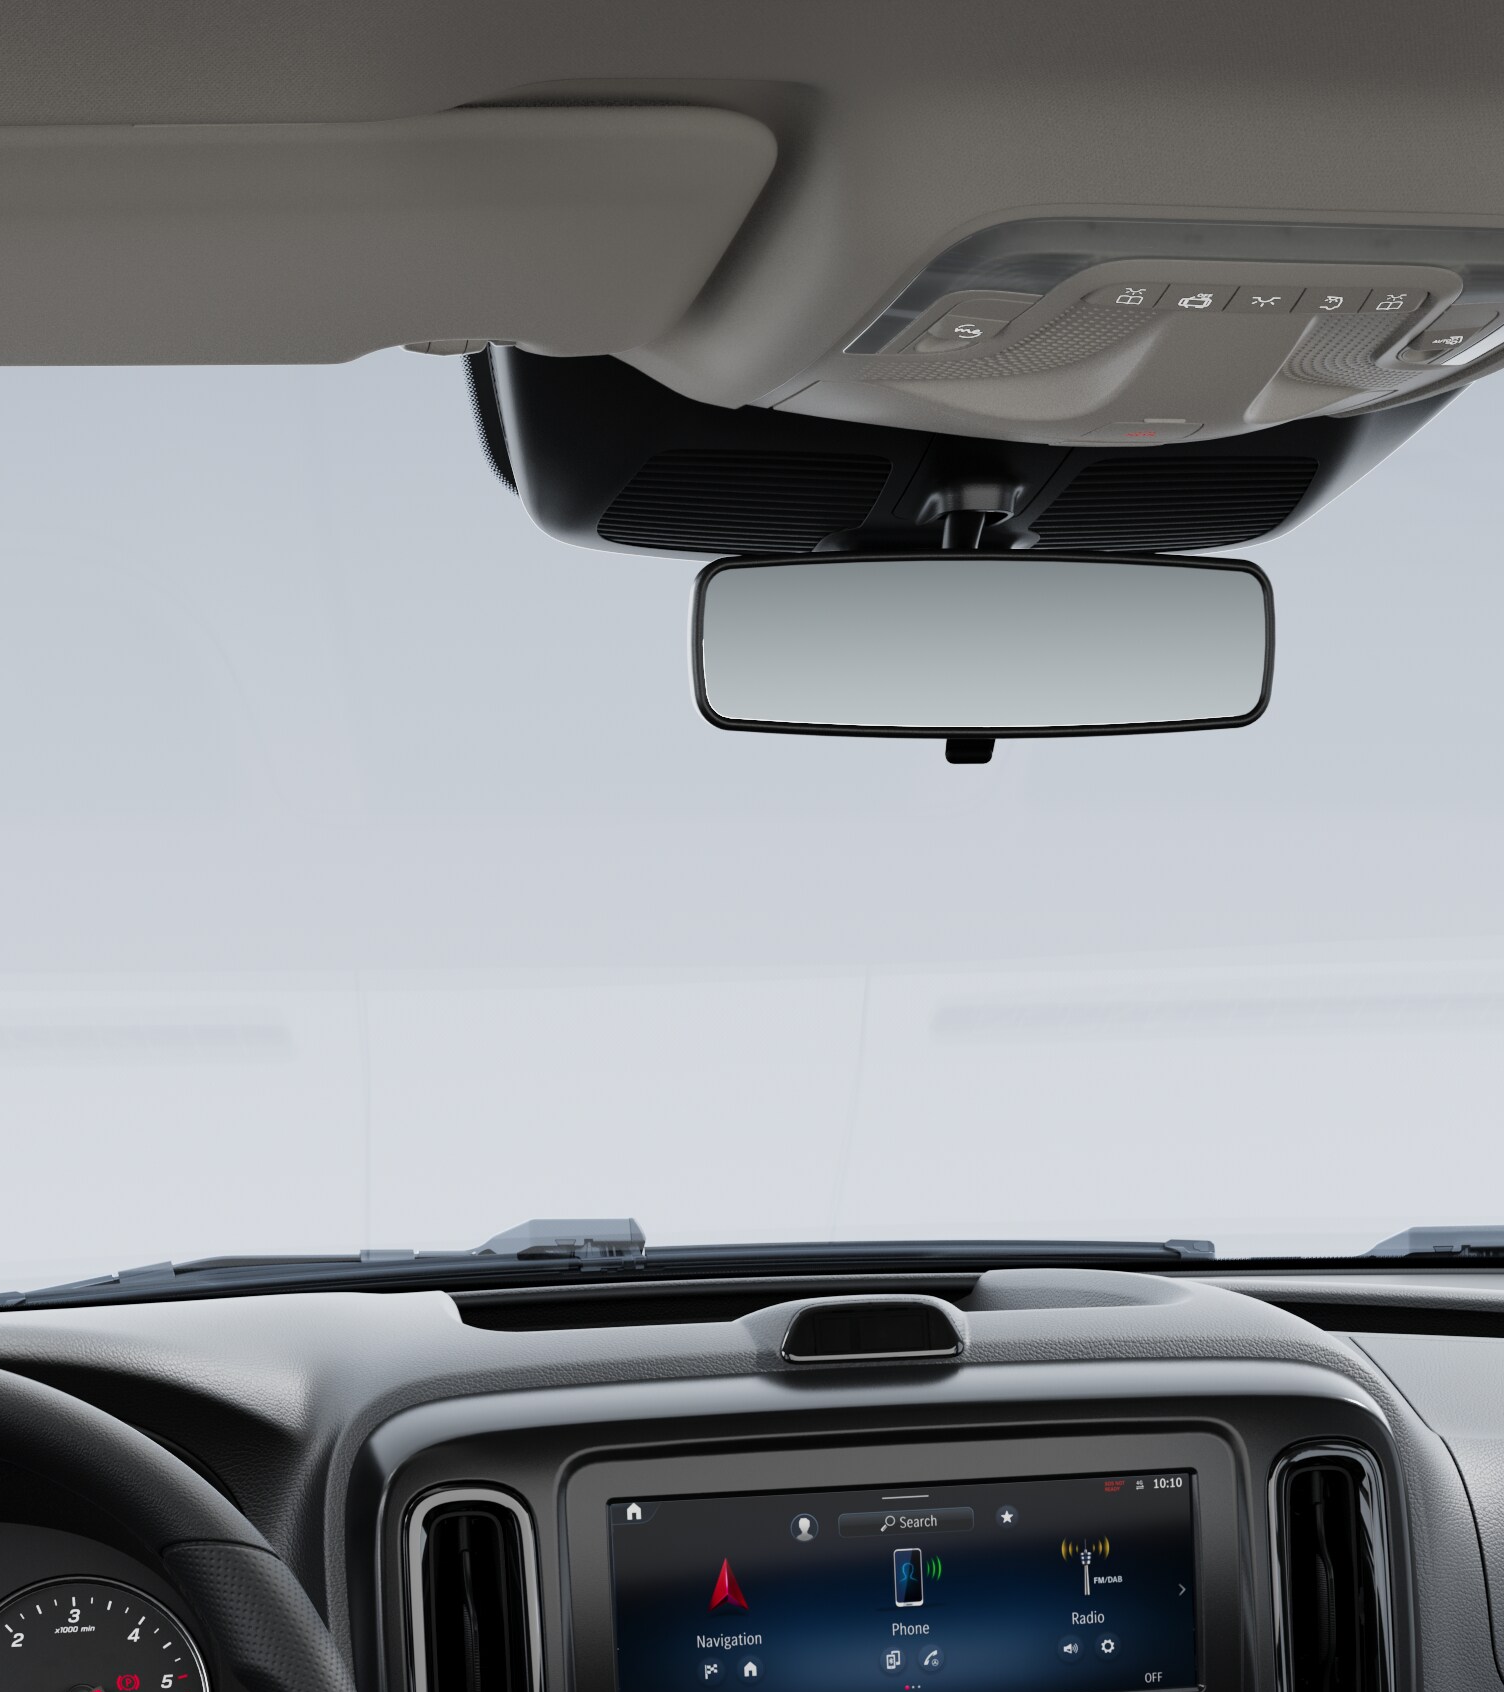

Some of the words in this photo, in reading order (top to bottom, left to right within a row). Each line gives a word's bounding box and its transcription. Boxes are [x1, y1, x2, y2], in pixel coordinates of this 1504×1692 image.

[1153, 1477, 1183, 1489] 10:10
[899, 1514, 938, 1530] Search
[1093, 1575, 1123, 1585] FM/DAB
[68, 1609, 81, 1623] 3
[1072, 1610, 1106, 1625] Radio
[128, 1628, 140, 1643] 4
[892, 1622, 930, 1637] Phone
[11, 1633, 25, 1648] 2
[696, 1631, 763, 1649] Navigation
[161, 1674, 174, 1689] 5
[1144, 1672, 1163, 1684] OFF
